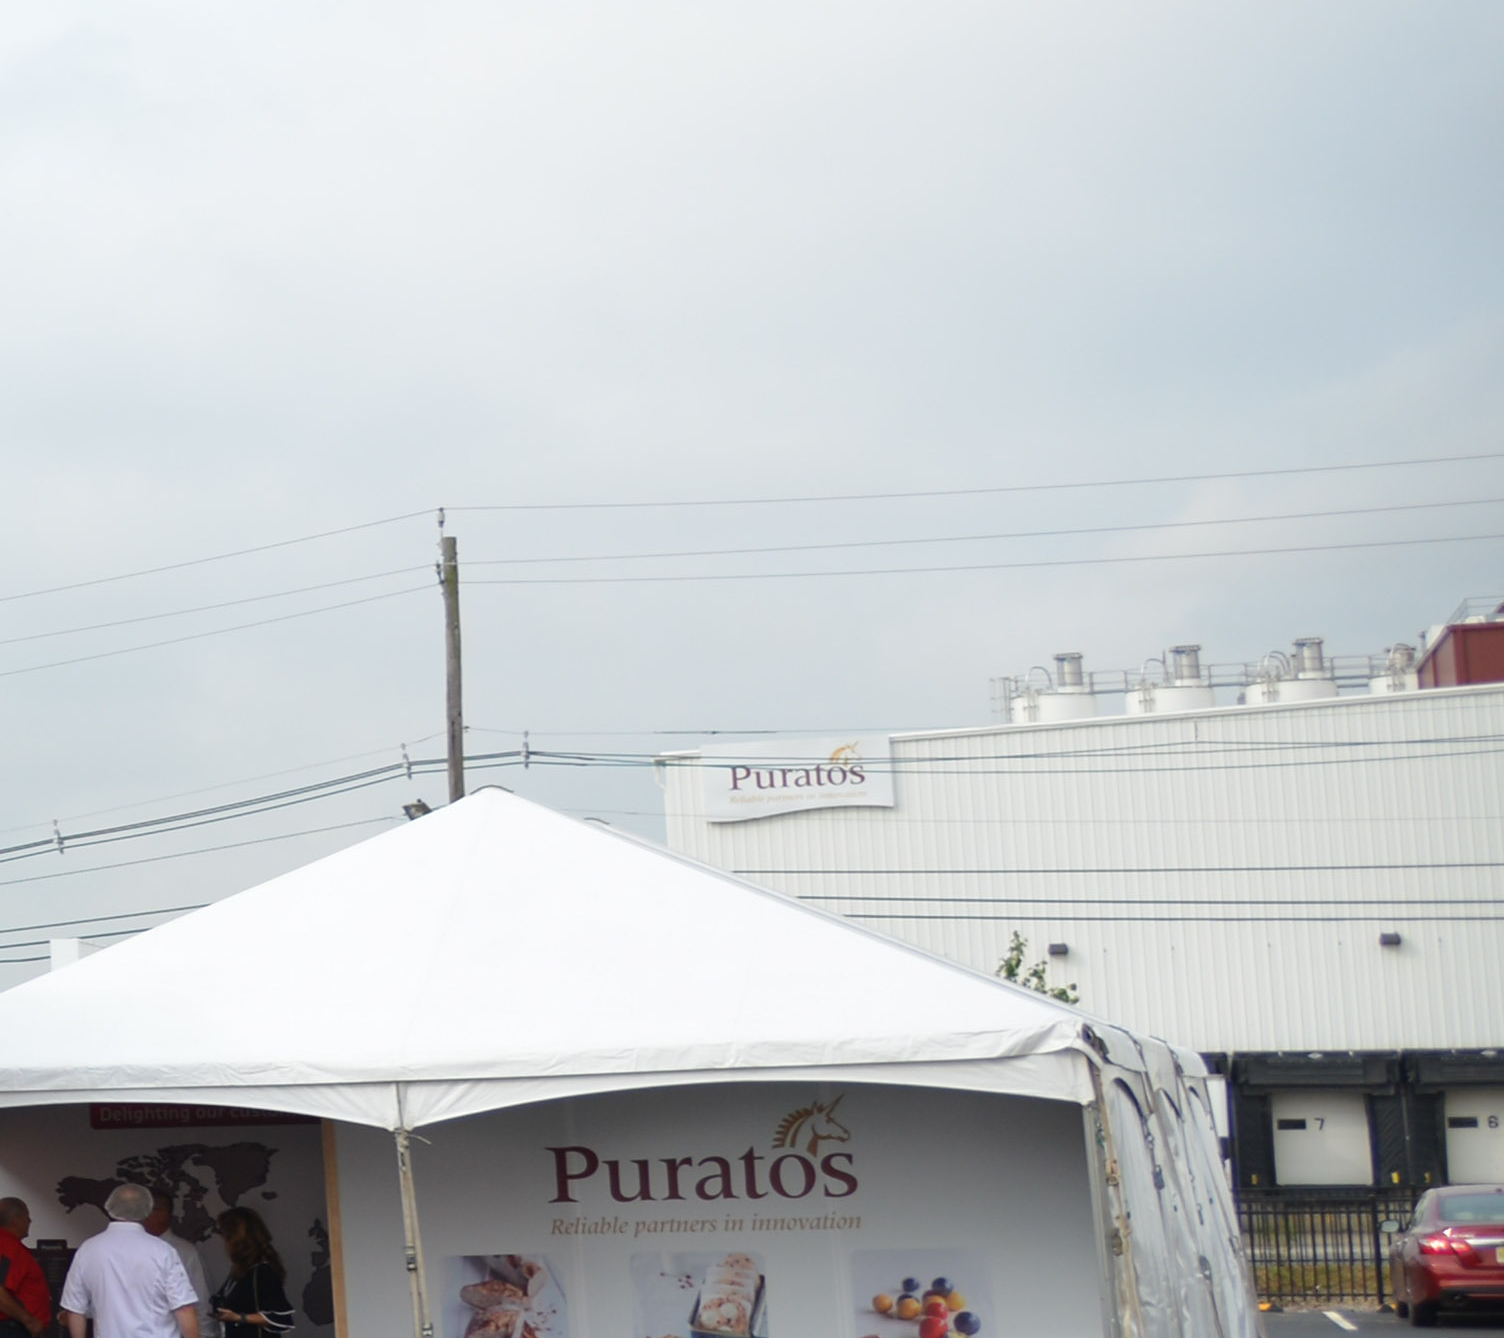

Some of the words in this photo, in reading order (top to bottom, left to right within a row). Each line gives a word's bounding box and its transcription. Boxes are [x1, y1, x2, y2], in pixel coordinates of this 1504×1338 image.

[729, 764, 866, 791] Puratos
[545, 1145, 859, 1204] Puratos
[551, 1216, 629, 1236] Reliable
[634, 1216, 717, 1238] partners
[724, 1213, 744, 1232] in
[751, 1211, 862, 1232] innovation
